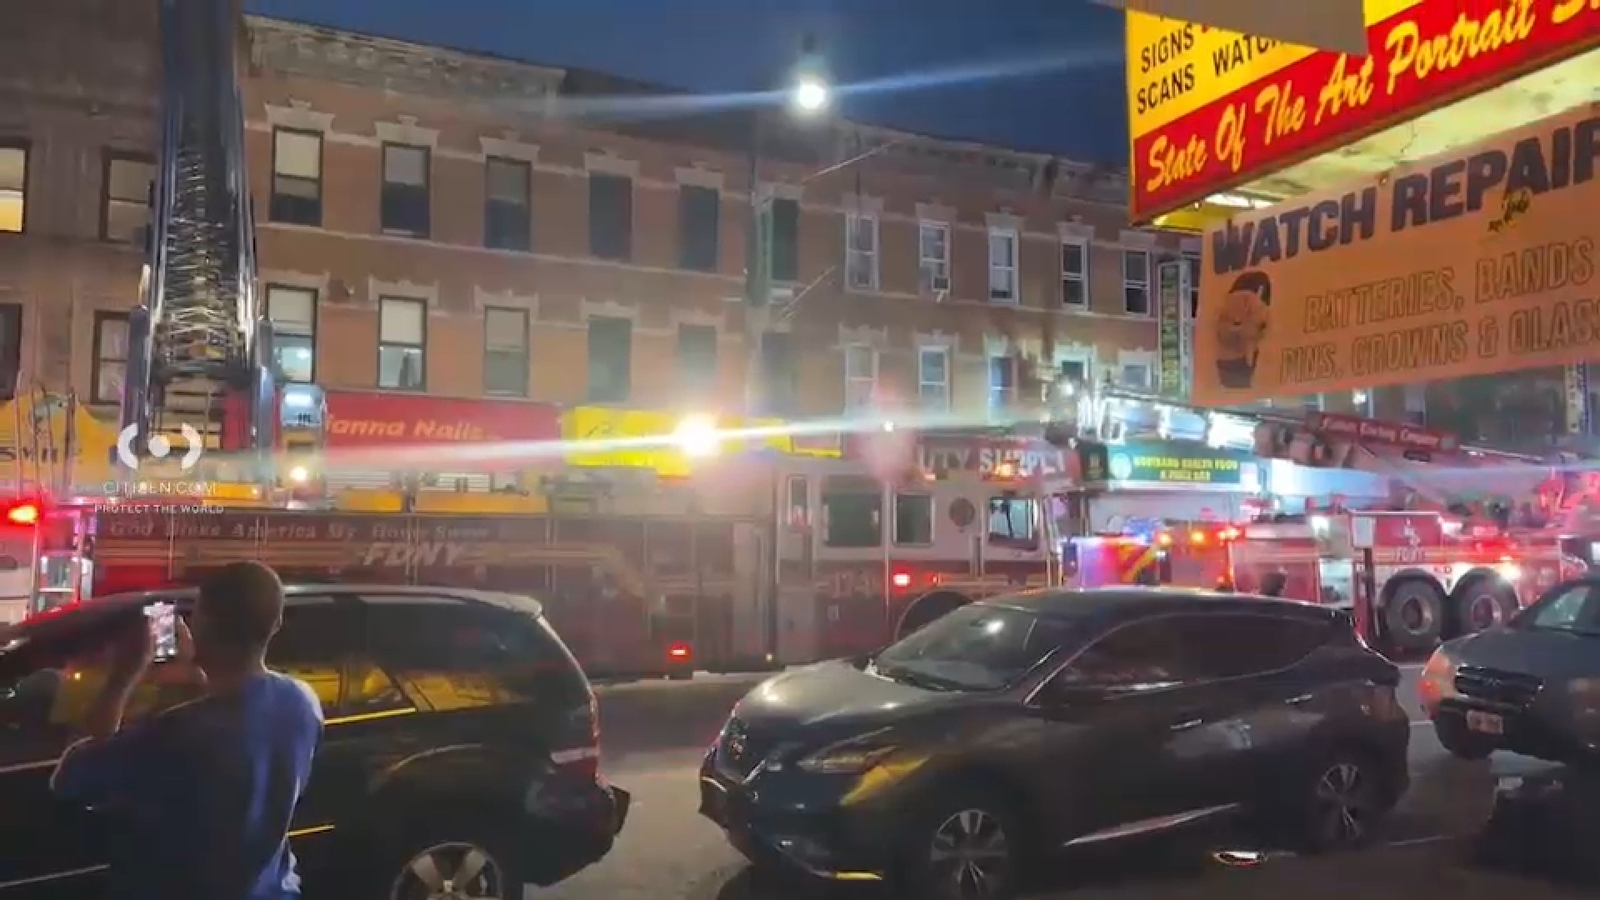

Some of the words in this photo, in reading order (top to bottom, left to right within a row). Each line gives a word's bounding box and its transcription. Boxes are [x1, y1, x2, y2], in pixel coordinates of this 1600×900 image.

[1141, 23, 1194, 73] SIGNS
[1138, 63, 1195, 115] SCANS
[1146, 134, 1208, 192] State
[1215, 102, 1246, 172] Of
[1255, 79, 1306, 145] The
[1314, 52, 1374, 125] Art
[1385, 0, 1536, 95] Portrait
[1213, 185, 1376, 275] WATCH
[1303, 267, 1464, 334] BATTERIES,
[1474, 237, 1594, 304] BANDS
[1351, 318, 1469, 376] CROWNS
[1478, 314, 1499, 358] &
[361, 542, 464, 566] FDNY
